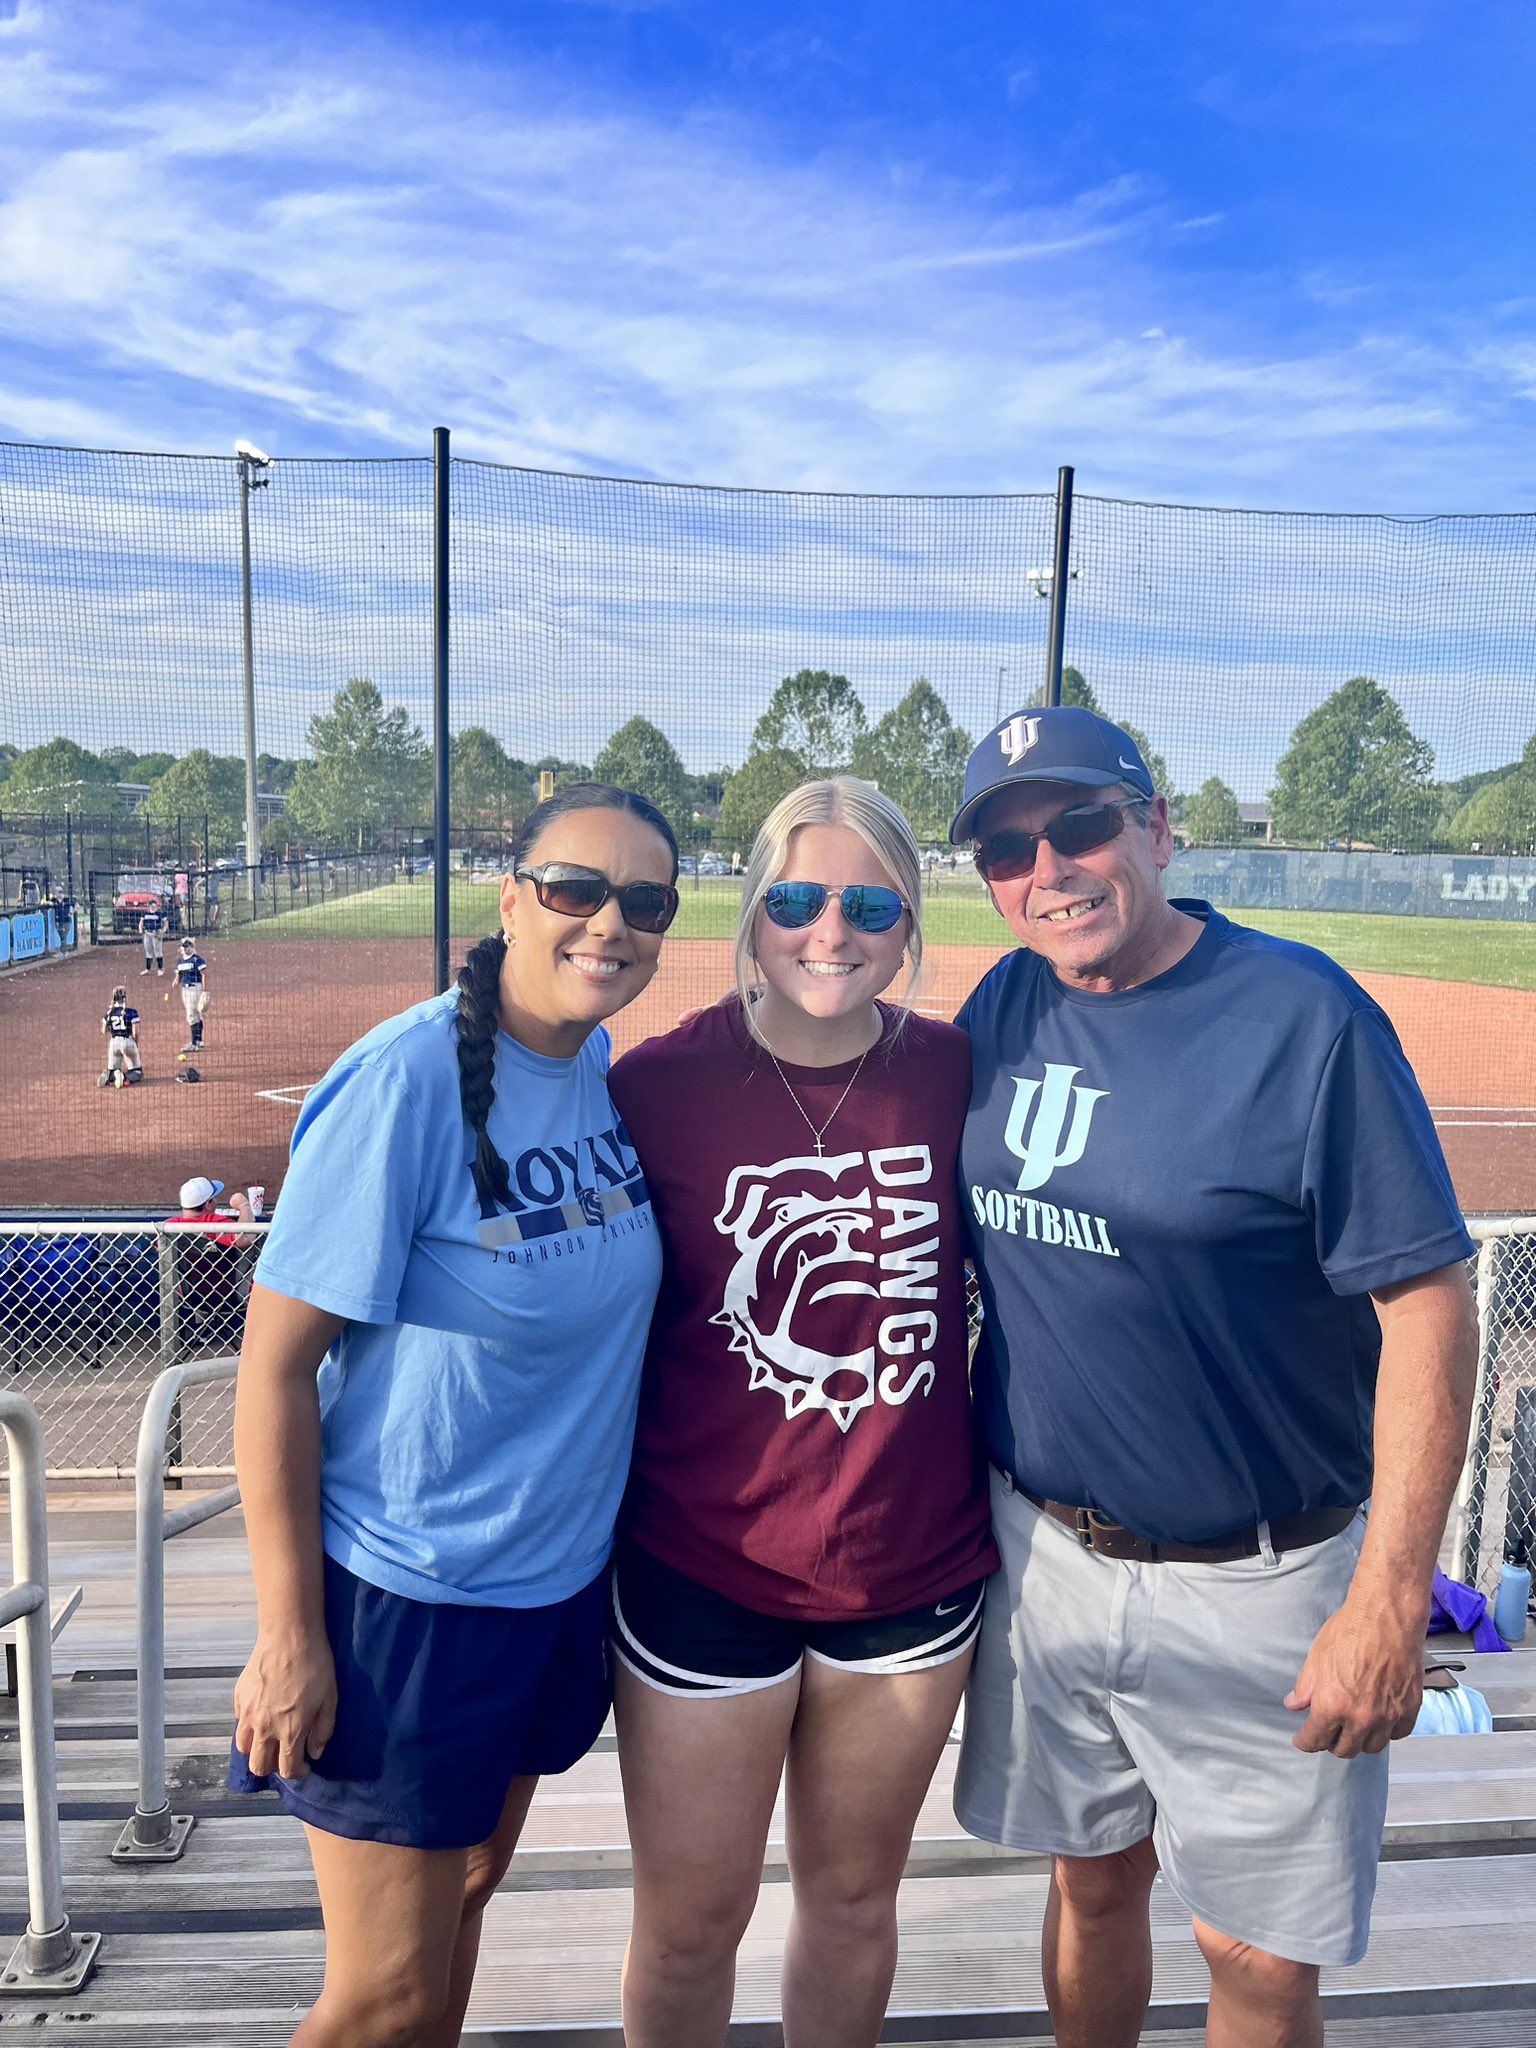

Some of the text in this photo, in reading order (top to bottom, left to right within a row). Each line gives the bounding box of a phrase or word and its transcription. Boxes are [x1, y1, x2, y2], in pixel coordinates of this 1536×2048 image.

[1440, 871, 1536, 903] LADY
[21, 919, 39, 933] LADY
[16, 936, 43, 953] HAWKS
[110, 1015, 128, 1031] 21
[971, 1185, 1120, 1257] SOFTBALL
[492, 1235, 585, 1264] JOHNSON
[867, 1144, 940, 1405] DAWGS
